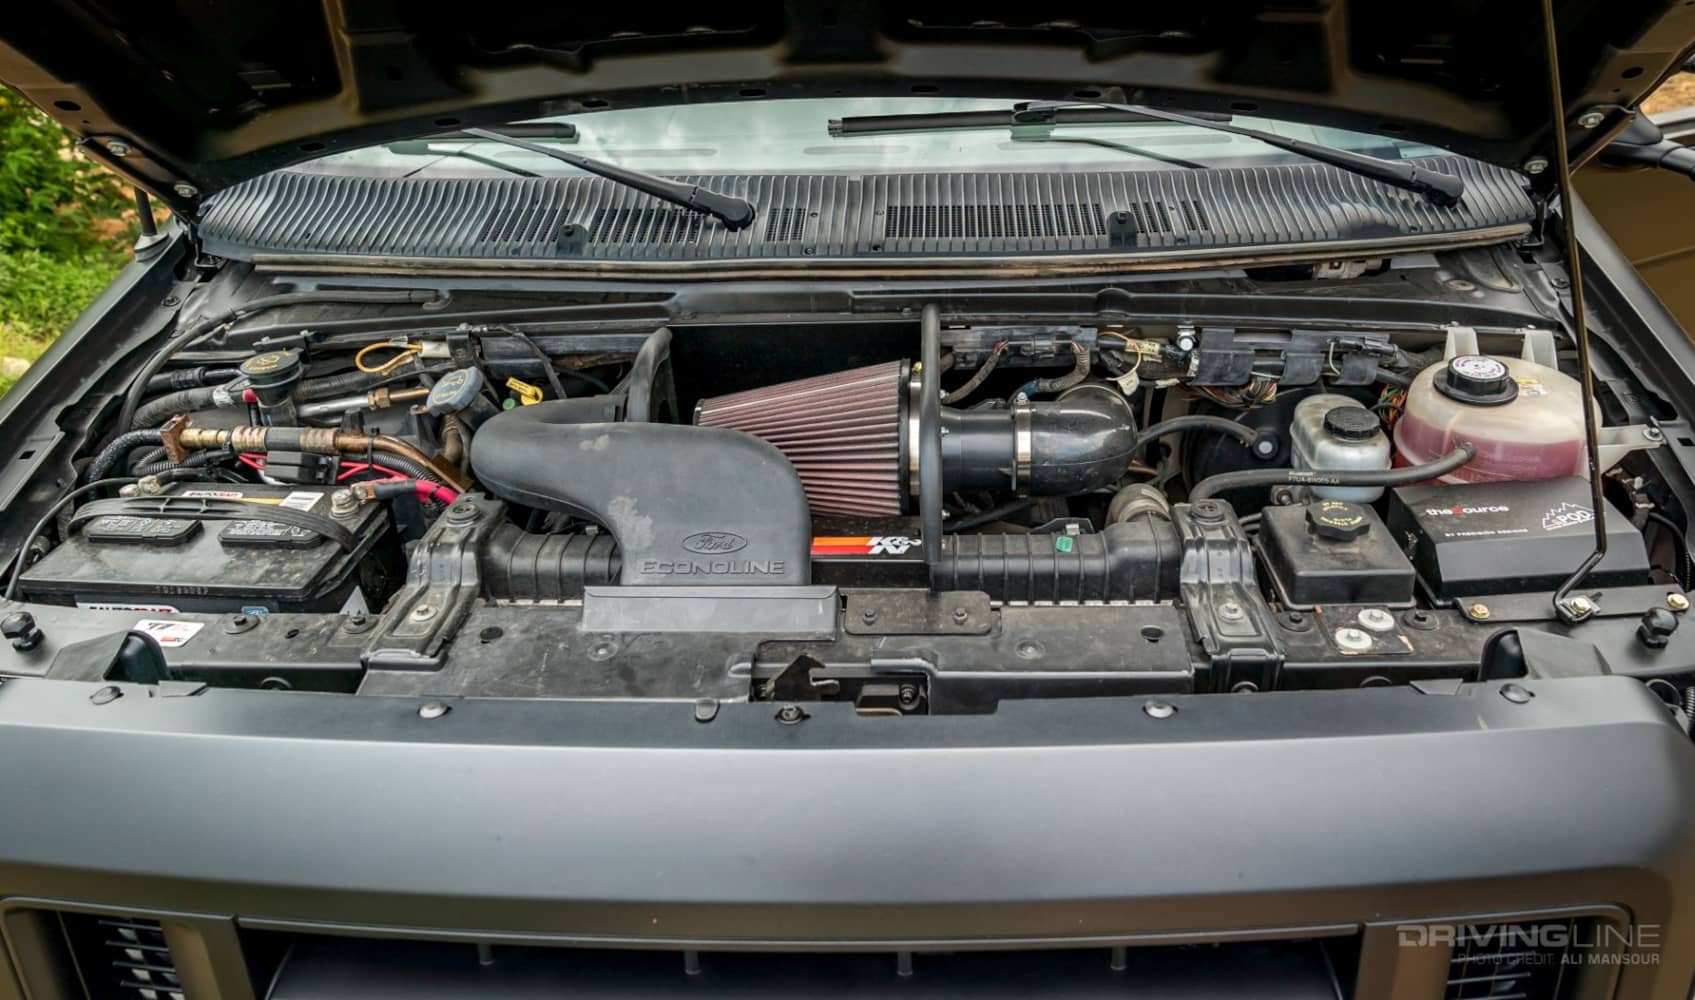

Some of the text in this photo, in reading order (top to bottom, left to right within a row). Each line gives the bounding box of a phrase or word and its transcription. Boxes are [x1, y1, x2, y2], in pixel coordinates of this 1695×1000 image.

[694, 533, 736, 550] Ford
[865, 536, 922, 554] K&N
[640, 559, 785, 575] ECONOLINE
